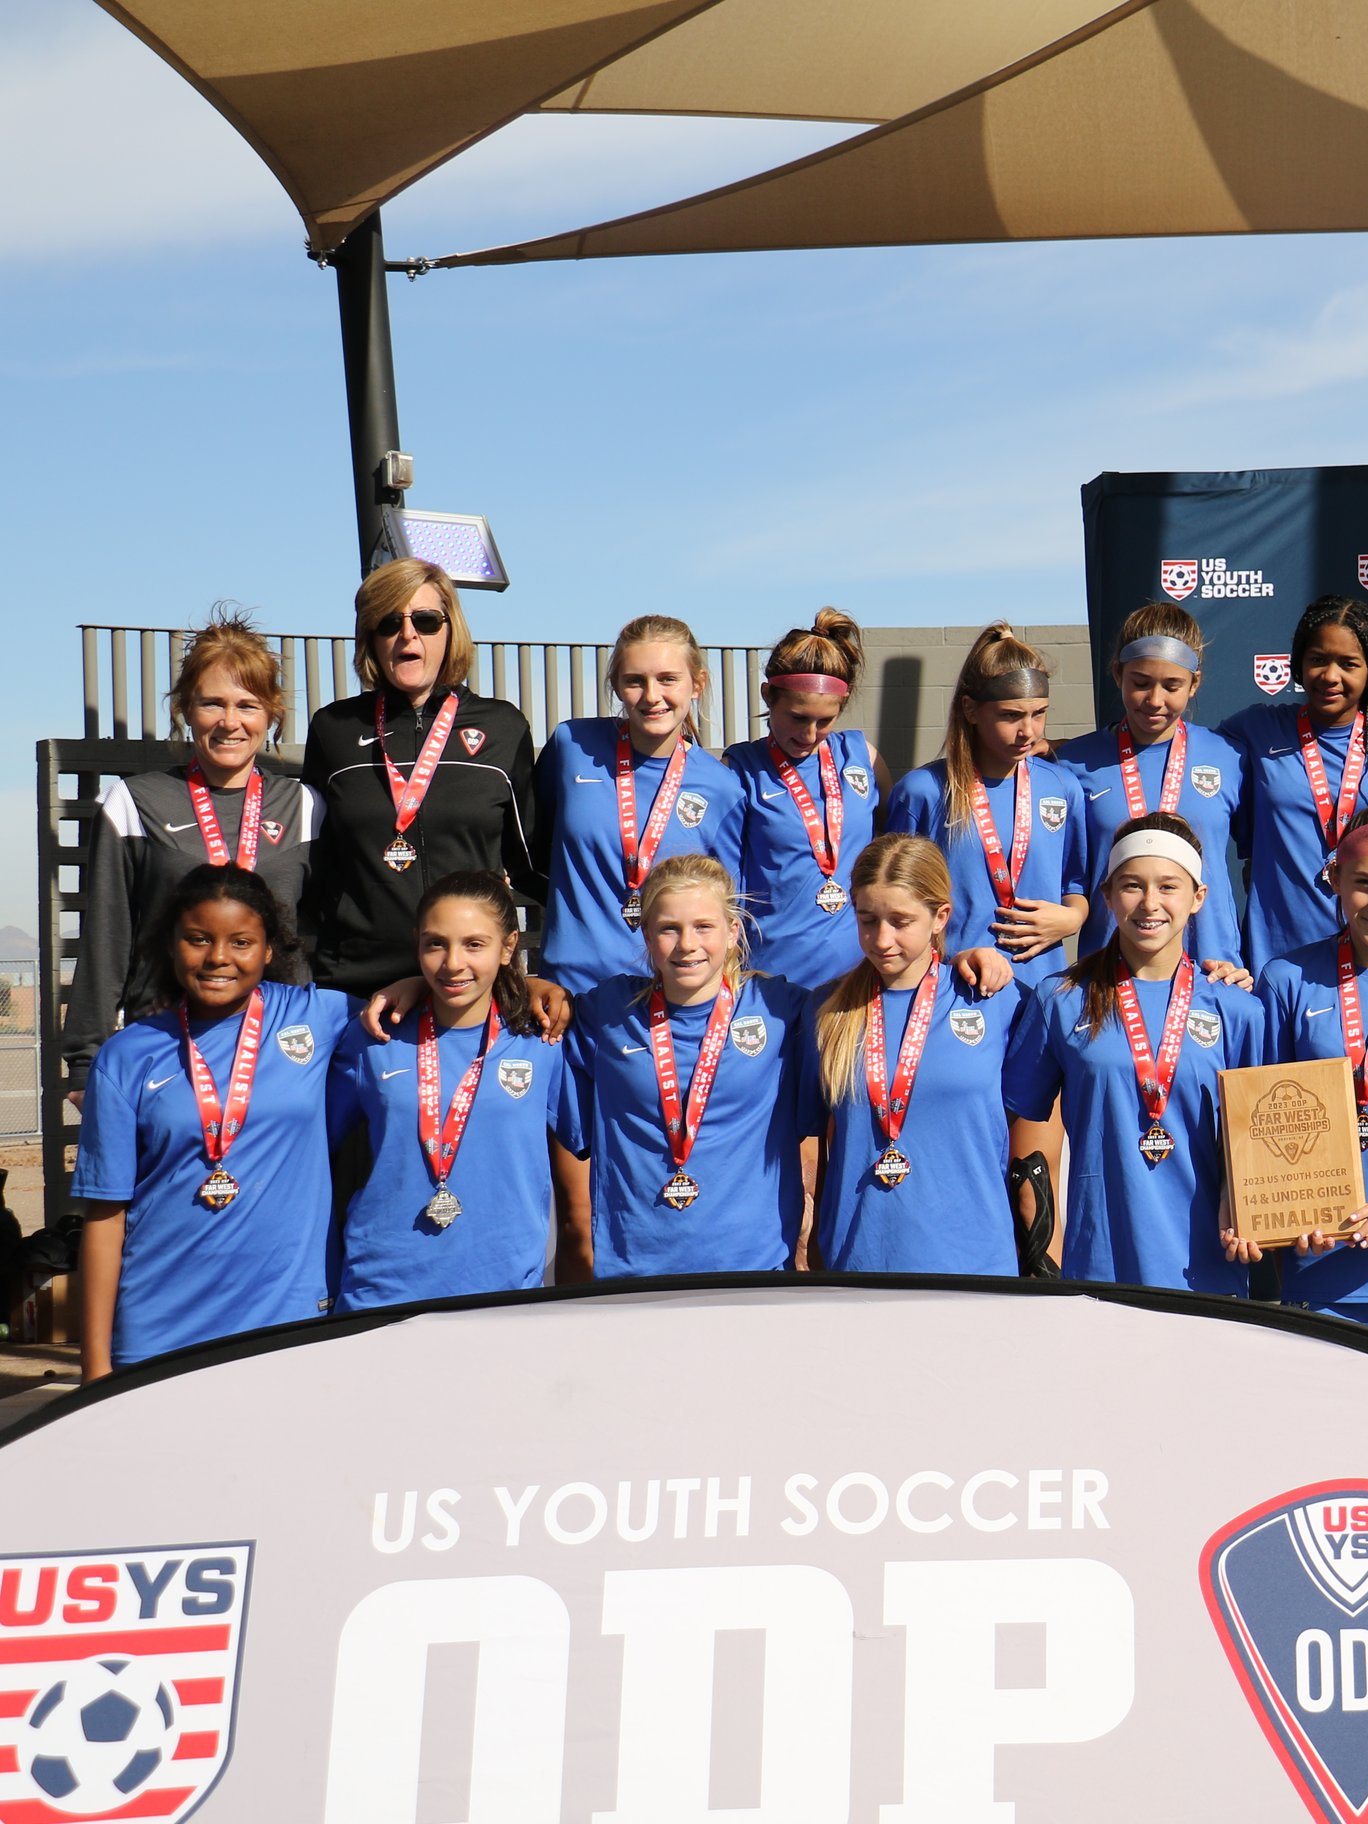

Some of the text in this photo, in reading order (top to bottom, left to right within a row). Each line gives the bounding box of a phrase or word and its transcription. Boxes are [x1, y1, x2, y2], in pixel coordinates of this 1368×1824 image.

[1201, 558, 1227, 572] US
[1201, 570, 1263, 585] YOUTH
[1201, 583, 1275, 598] SOCCER
[414, 711, 452, 787] FINALIST
[1302, 731, 1330, 806] FINALIST
[194, 786, 226, 859] FINALIST
[619, 759, 636, 840] FINALIST
[779, 760, 821, 828] FINALIST
[1118, 980, 1151, 1063] FINALIST
[1341, 961, 1362, 1049] FINALIST
[233, 1016, 260, 1105] FINALIST
[653, 1010, 678, 1102] FINALIST
[1252, 1120, 1328, 1138] CHAMPIONSHIPS
[1258, 1108, 1319, 1126] FAR WEST
[1268, 1101, 1289, 1110] 2023
[1243, 1168, 1347, 1187] 2023 US YOUTH SOCCER
[1243, 1184, 1352, 1207] 14 & UNDER GIRLS
[1251, 1205, 1346, 1232] FINALIST
[371, 1468, 1113, 1554] US YOUTH SOCCER
[323, 1556, 1136, 1824] ODP
